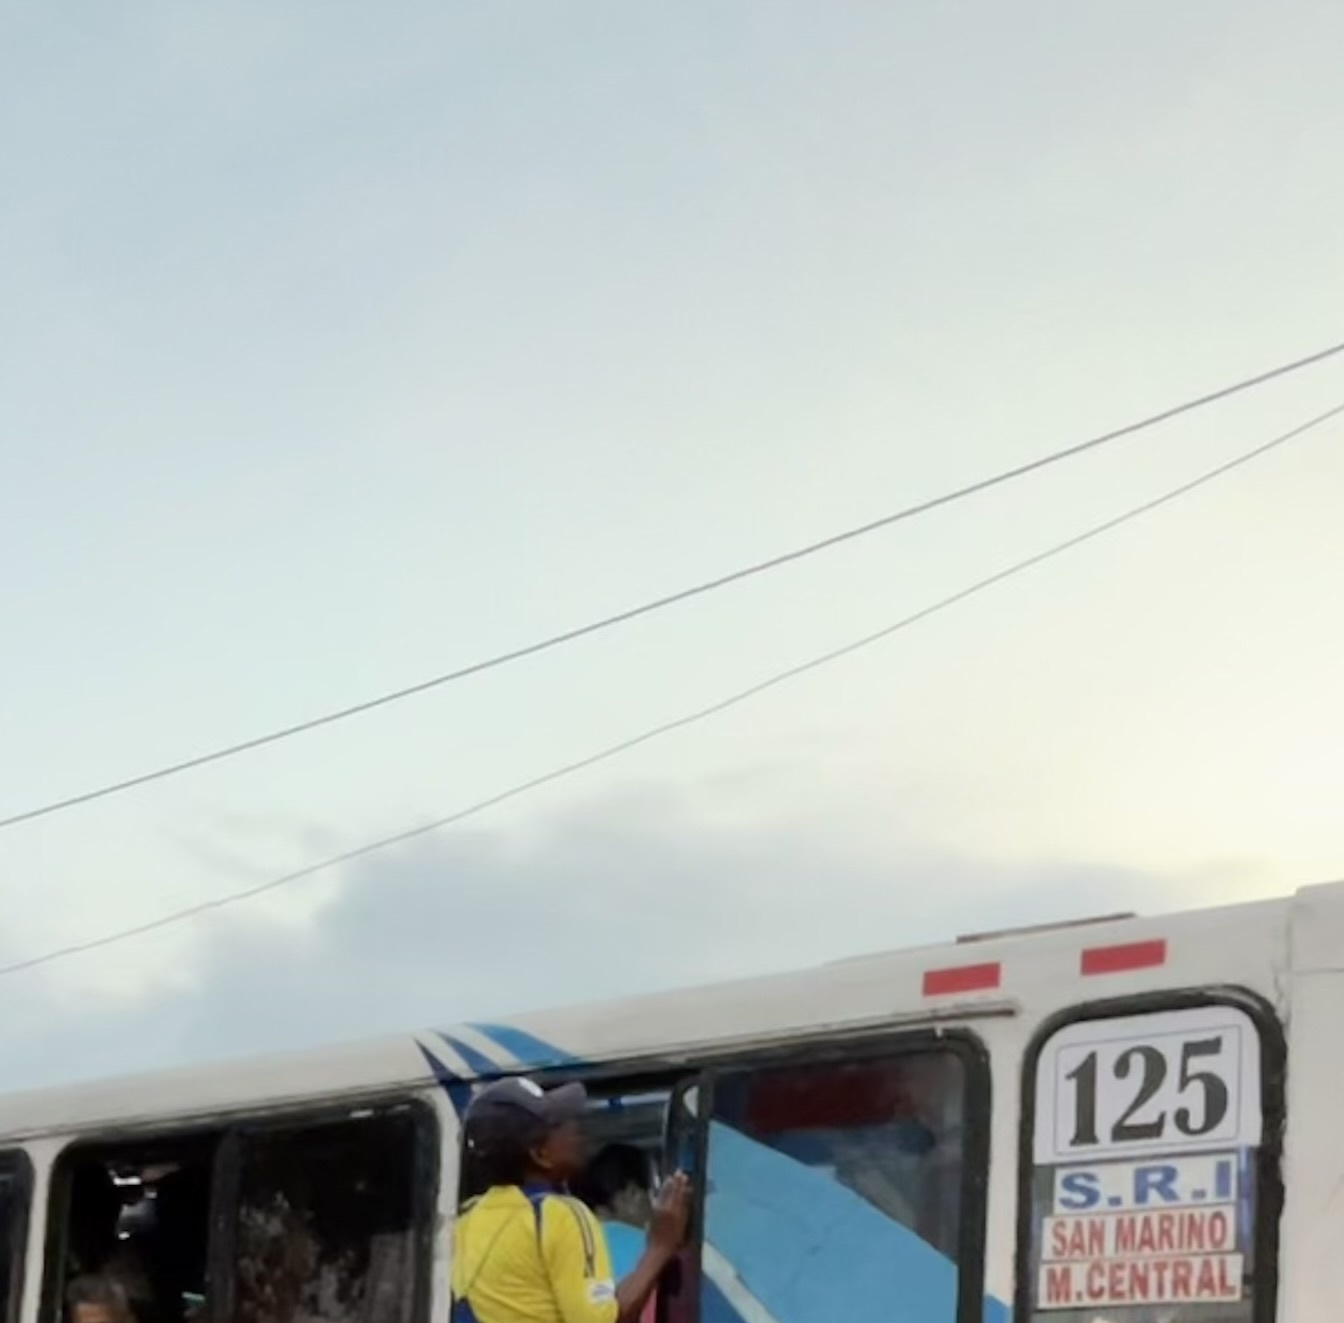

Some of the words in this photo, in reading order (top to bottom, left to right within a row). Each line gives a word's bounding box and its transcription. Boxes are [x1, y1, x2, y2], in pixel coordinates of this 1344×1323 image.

[1064, 1036, 1228, 1147] 125
[1058, 1161, 1233, 1210] S.R.I
[1051, 1216, 1105, 1257] SAN
[1114, 1211, 1227, 1254] MARINO
[1046, 1259, 1236, 1302] M.CENTRAL
